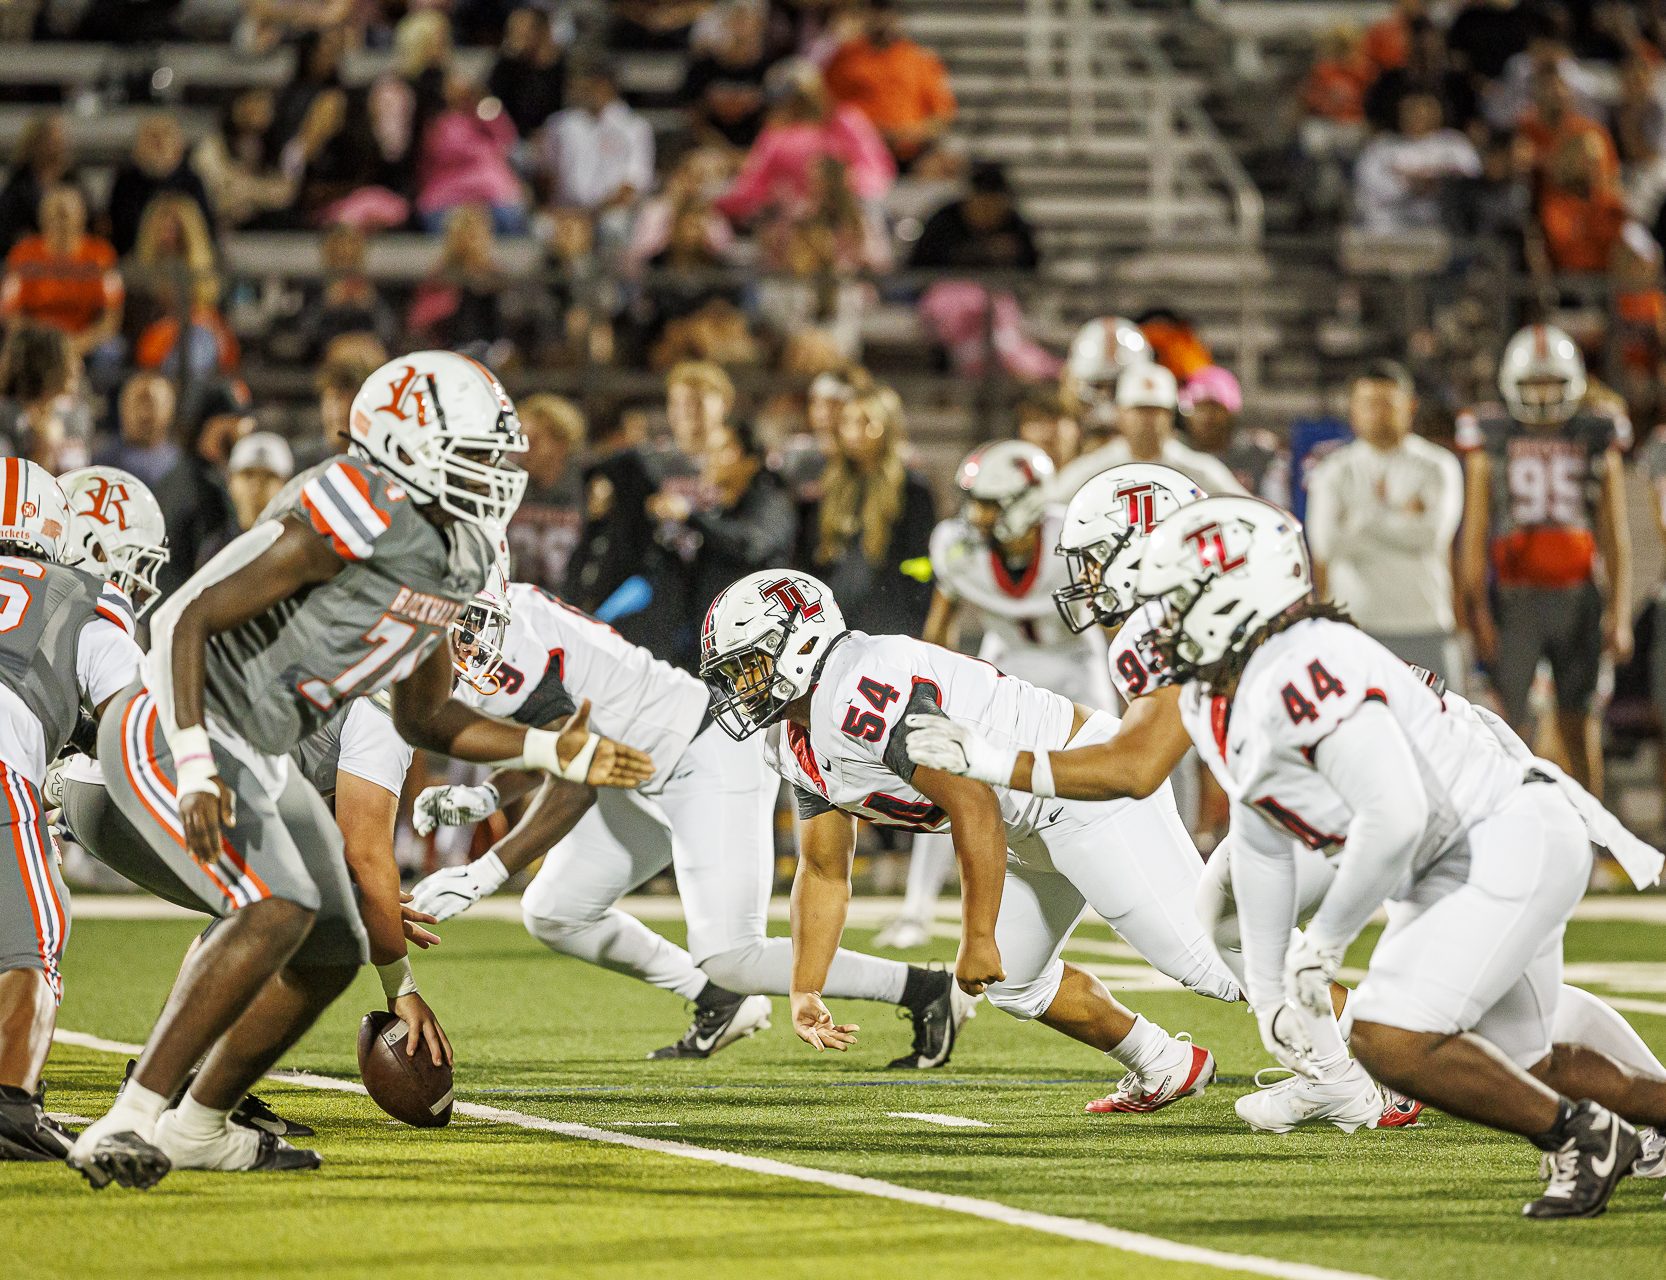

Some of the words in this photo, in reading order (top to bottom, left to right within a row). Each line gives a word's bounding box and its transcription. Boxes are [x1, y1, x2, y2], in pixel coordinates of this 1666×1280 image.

[77, 477, 130, 531] R
[1509, 457, 1587, 526] 95
[1182, 521, 1248, 575] TL
[759, 577, 824, 623] TL
[840, 675, 901, 743] 54
[1280, 658, 1346, 726] 44
